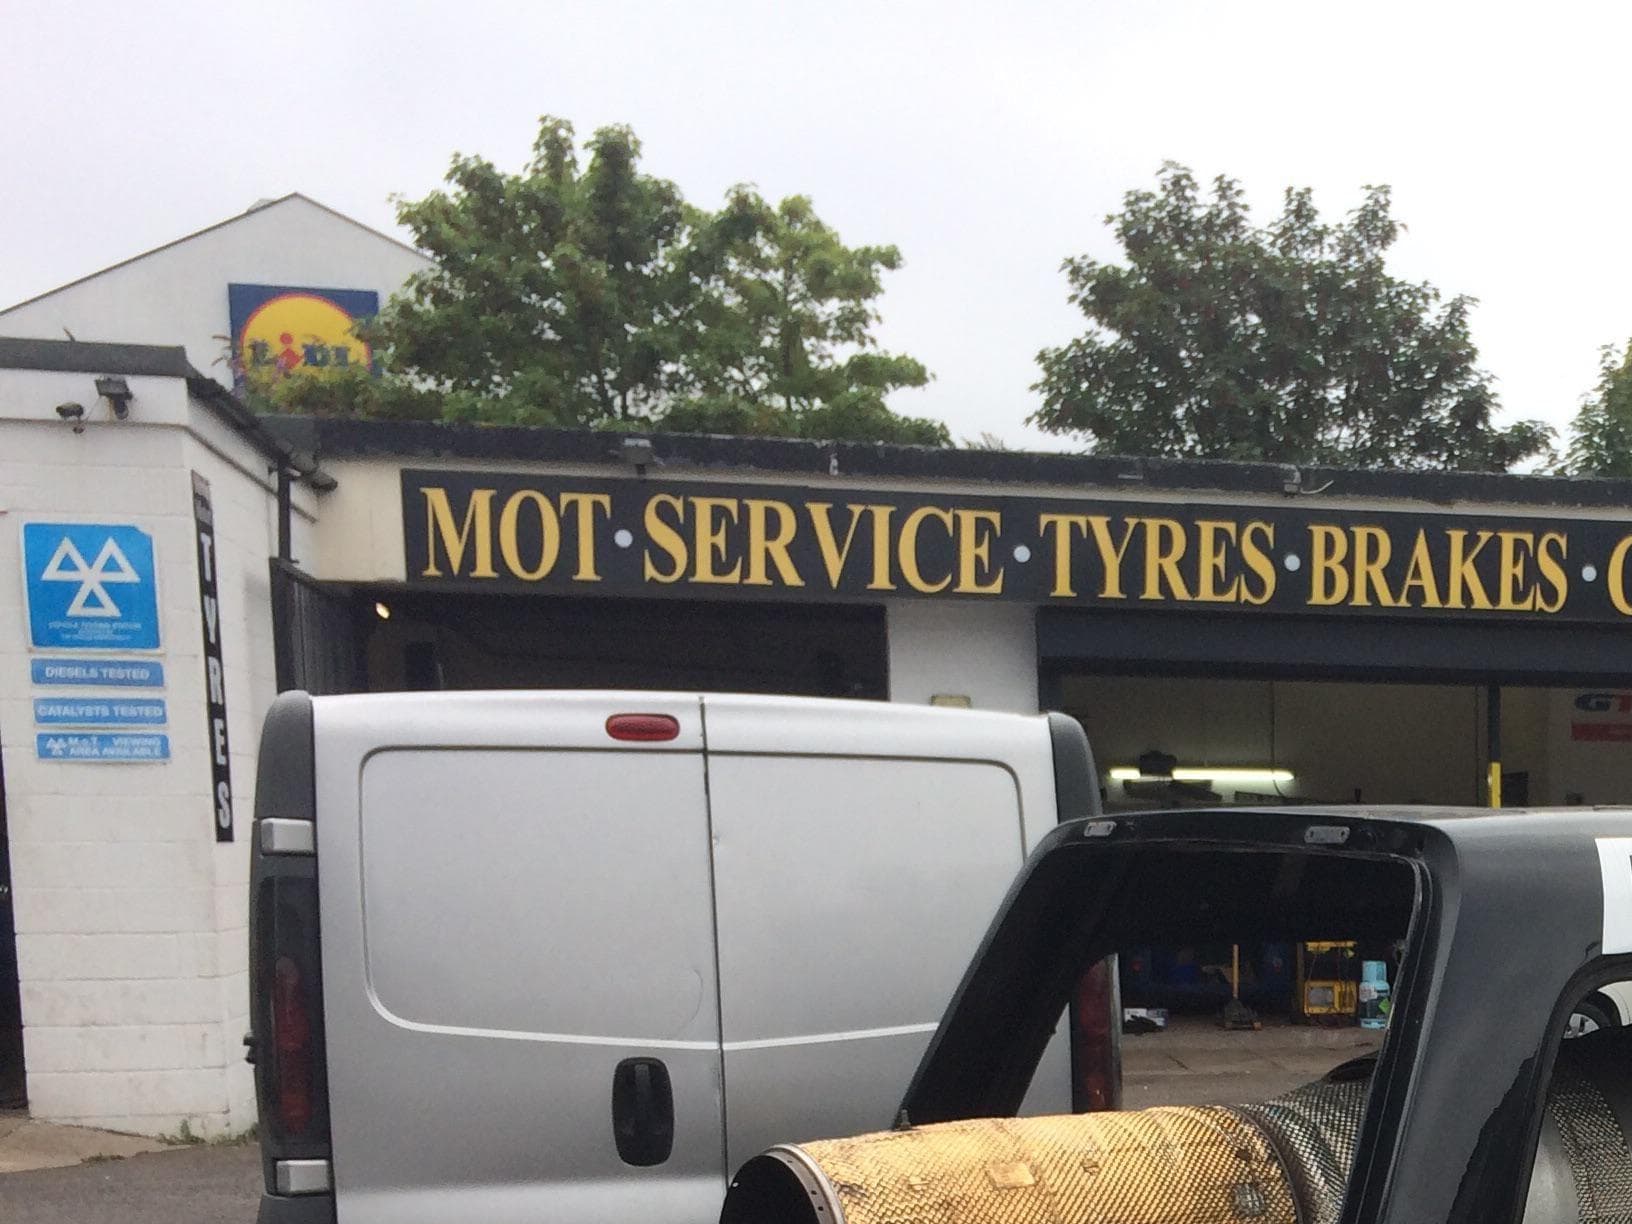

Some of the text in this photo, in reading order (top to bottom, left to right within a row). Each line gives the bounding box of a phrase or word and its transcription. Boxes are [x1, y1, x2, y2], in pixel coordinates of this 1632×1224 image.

[422, 487, 611, 582] MOT
[644, 493, 1004, 595] SERVICE
[1040, 514, 1276, 605] TYRES
[1307, 525, 1569, 613] BRAKES
[45, 666, 150, 680] DIESELS TESTED
[200, 532, 230, 829] TYRES
[113, 705, 163, 717] TESTED
